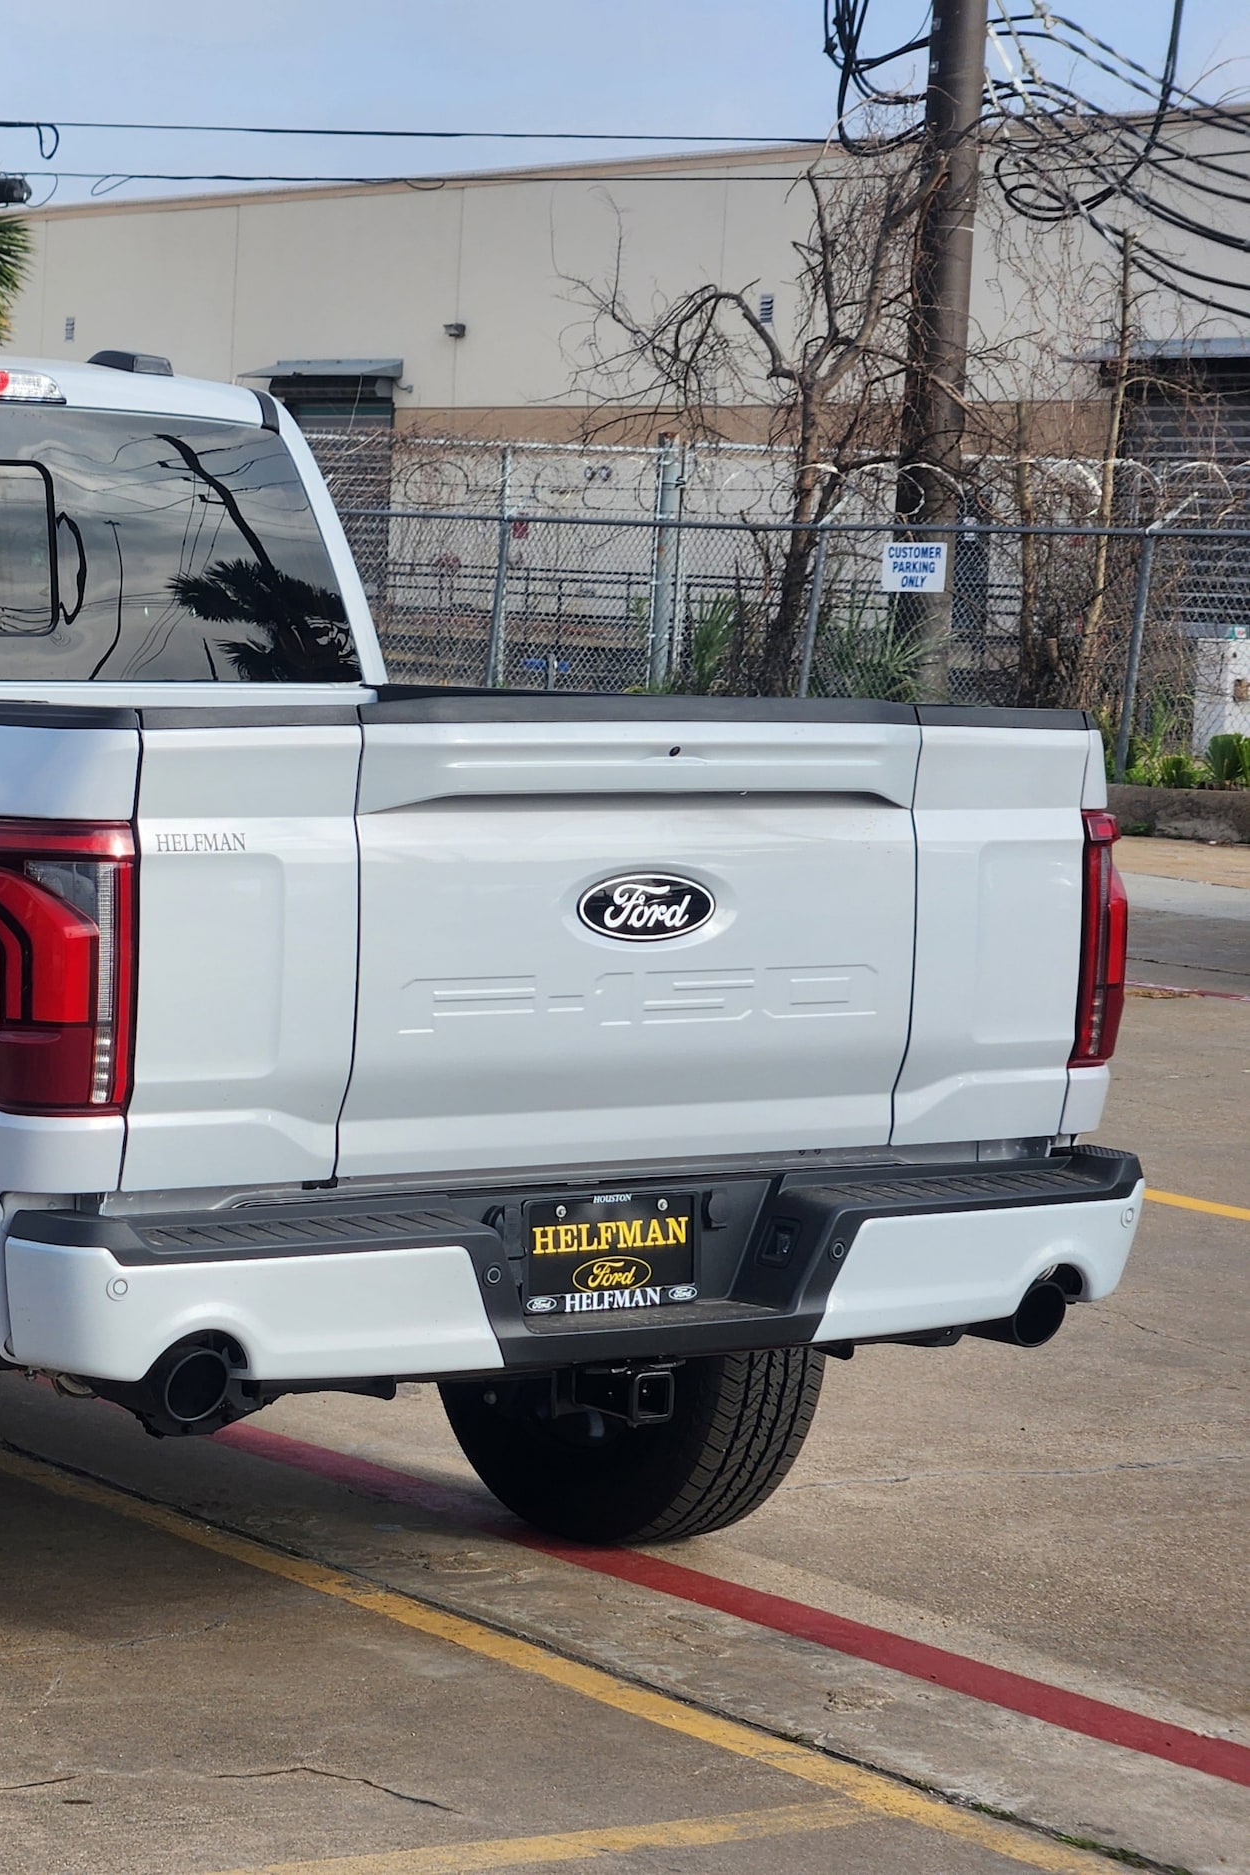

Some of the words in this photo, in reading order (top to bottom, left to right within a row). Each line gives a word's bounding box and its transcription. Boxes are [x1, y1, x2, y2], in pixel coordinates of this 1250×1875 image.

[888, 546, 942, 559] CUSTOMER
[892, 561, 936, 573] PARKING
[900, 575, 927, 588] ONLY
[155, 832, 246, 852] HELFMAN
[603, 883, 692, 928] Ford
[593, 1194, 634, 1204] HOUSTON
[532, 1216, 689, 1255] HELFMAN
[587, 1261, 637, 1288] Ford
[564, 1286, 662, 1312] HELFMAN
